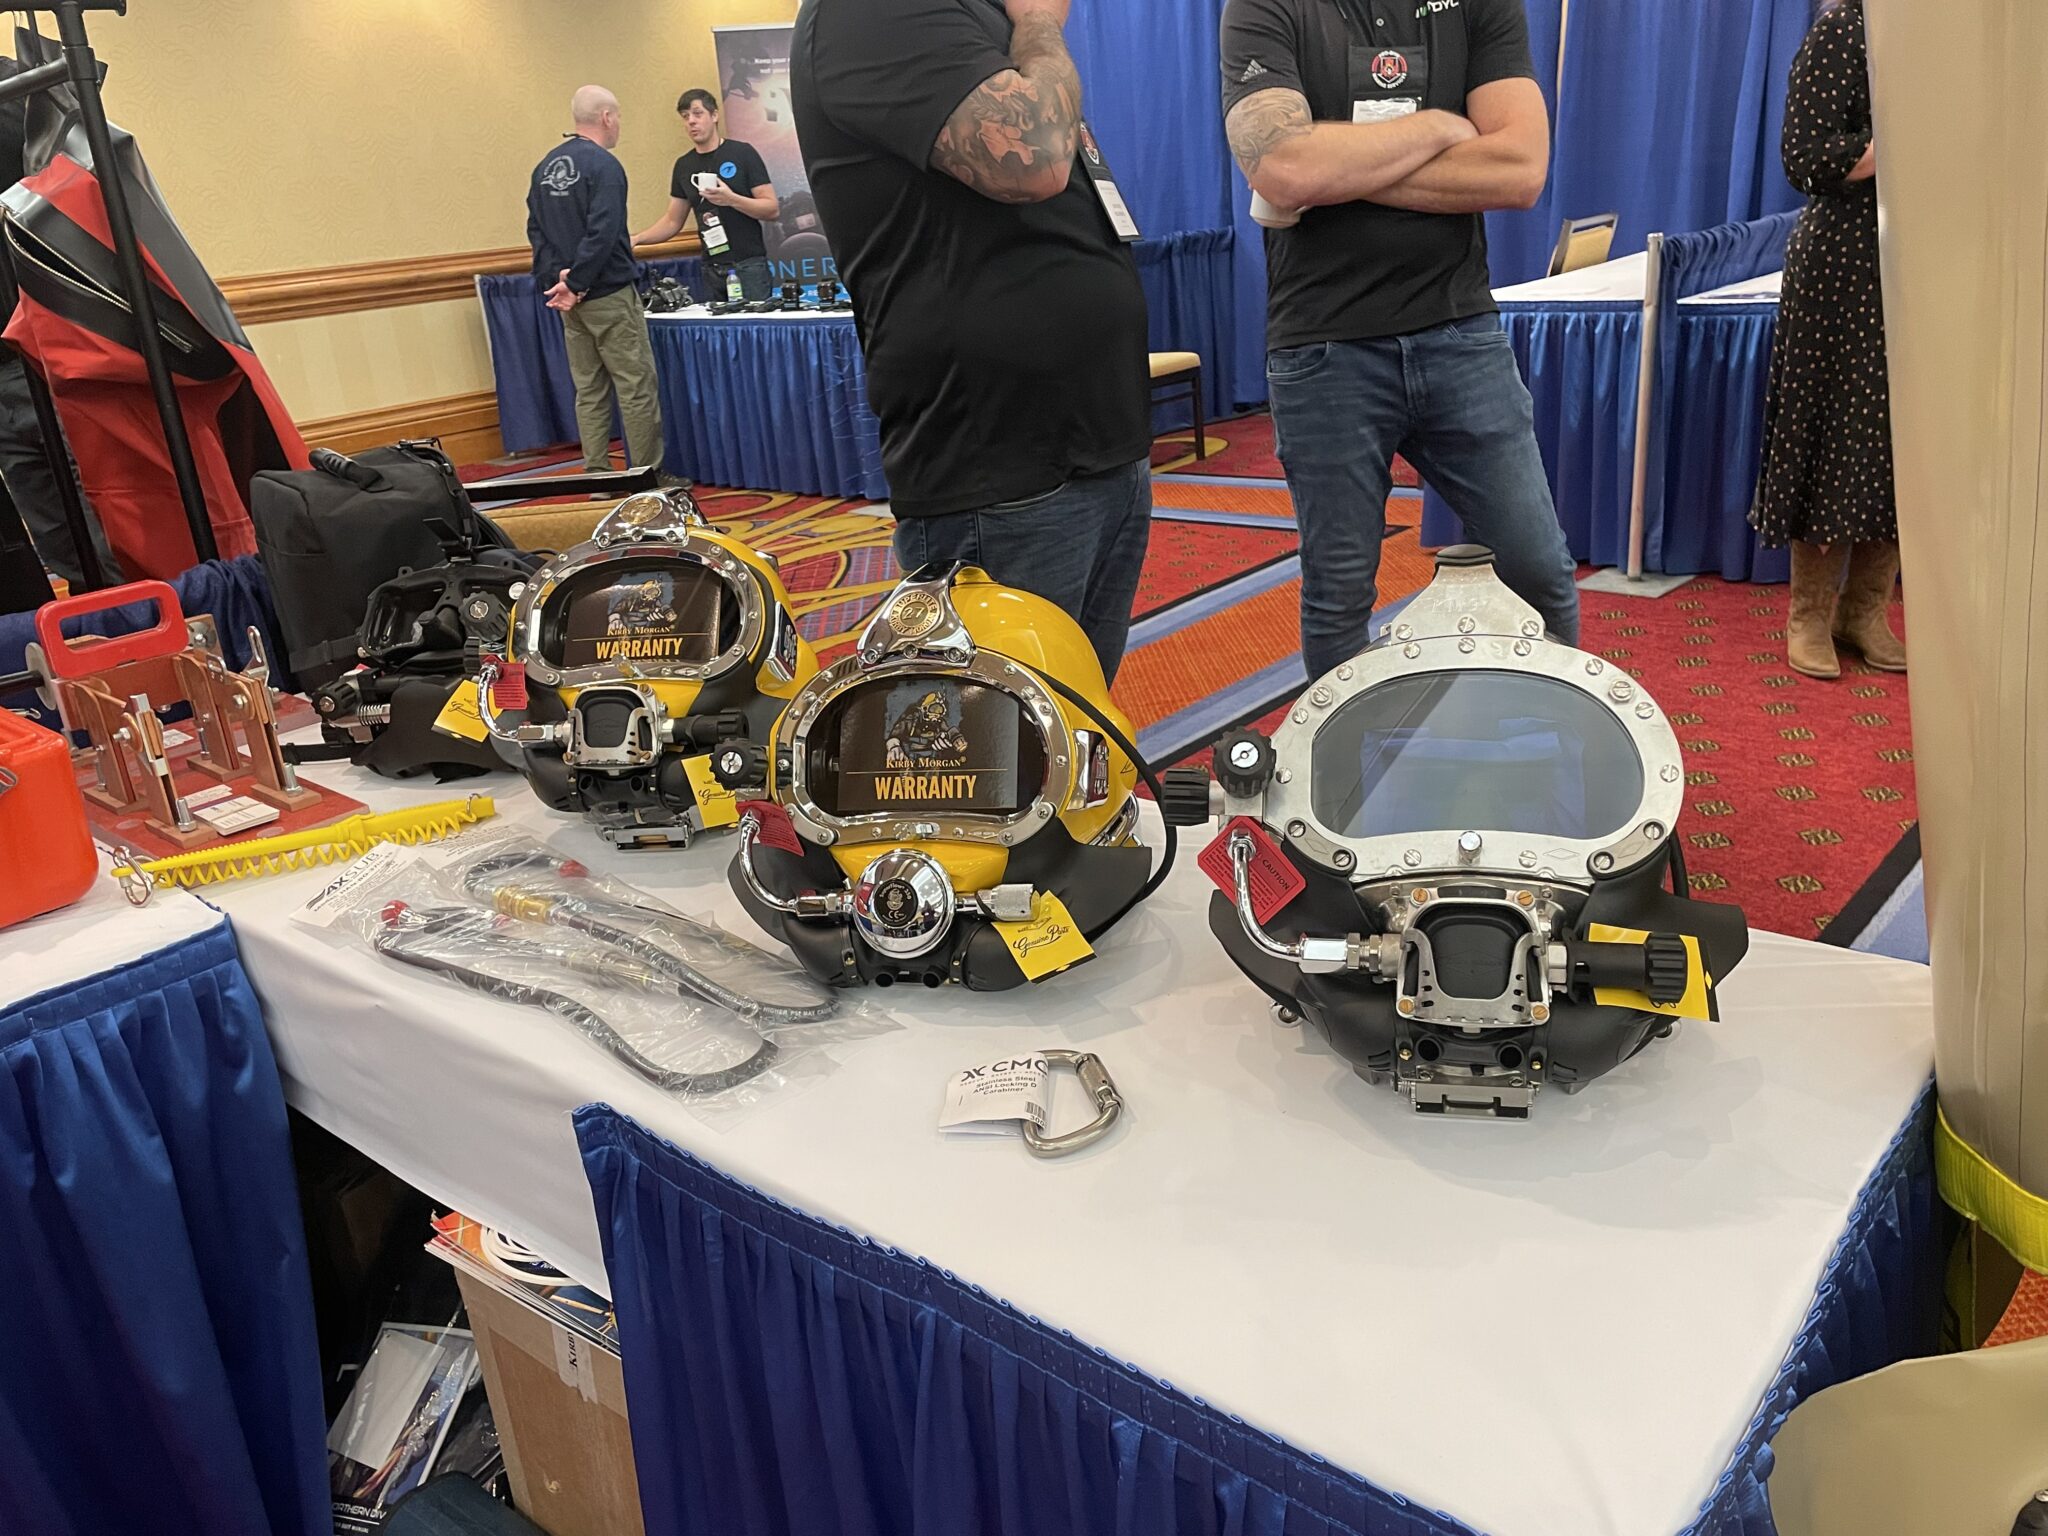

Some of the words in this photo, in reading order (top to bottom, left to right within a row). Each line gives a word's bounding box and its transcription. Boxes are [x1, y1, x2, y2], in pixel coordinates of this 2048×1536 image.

[902, 606, 925, 621] 27
[596, 637, 684, 660] WARRANTY
[886, 759, 915, 769] KIRBY
[874, 775, 977, 800] WARRANTY
[1262, 859, 1290, 890] CAUTION
[983, 1087, 1025, 1096] Carabiner
[332, 1502, 371, 1517] ORTHERN
